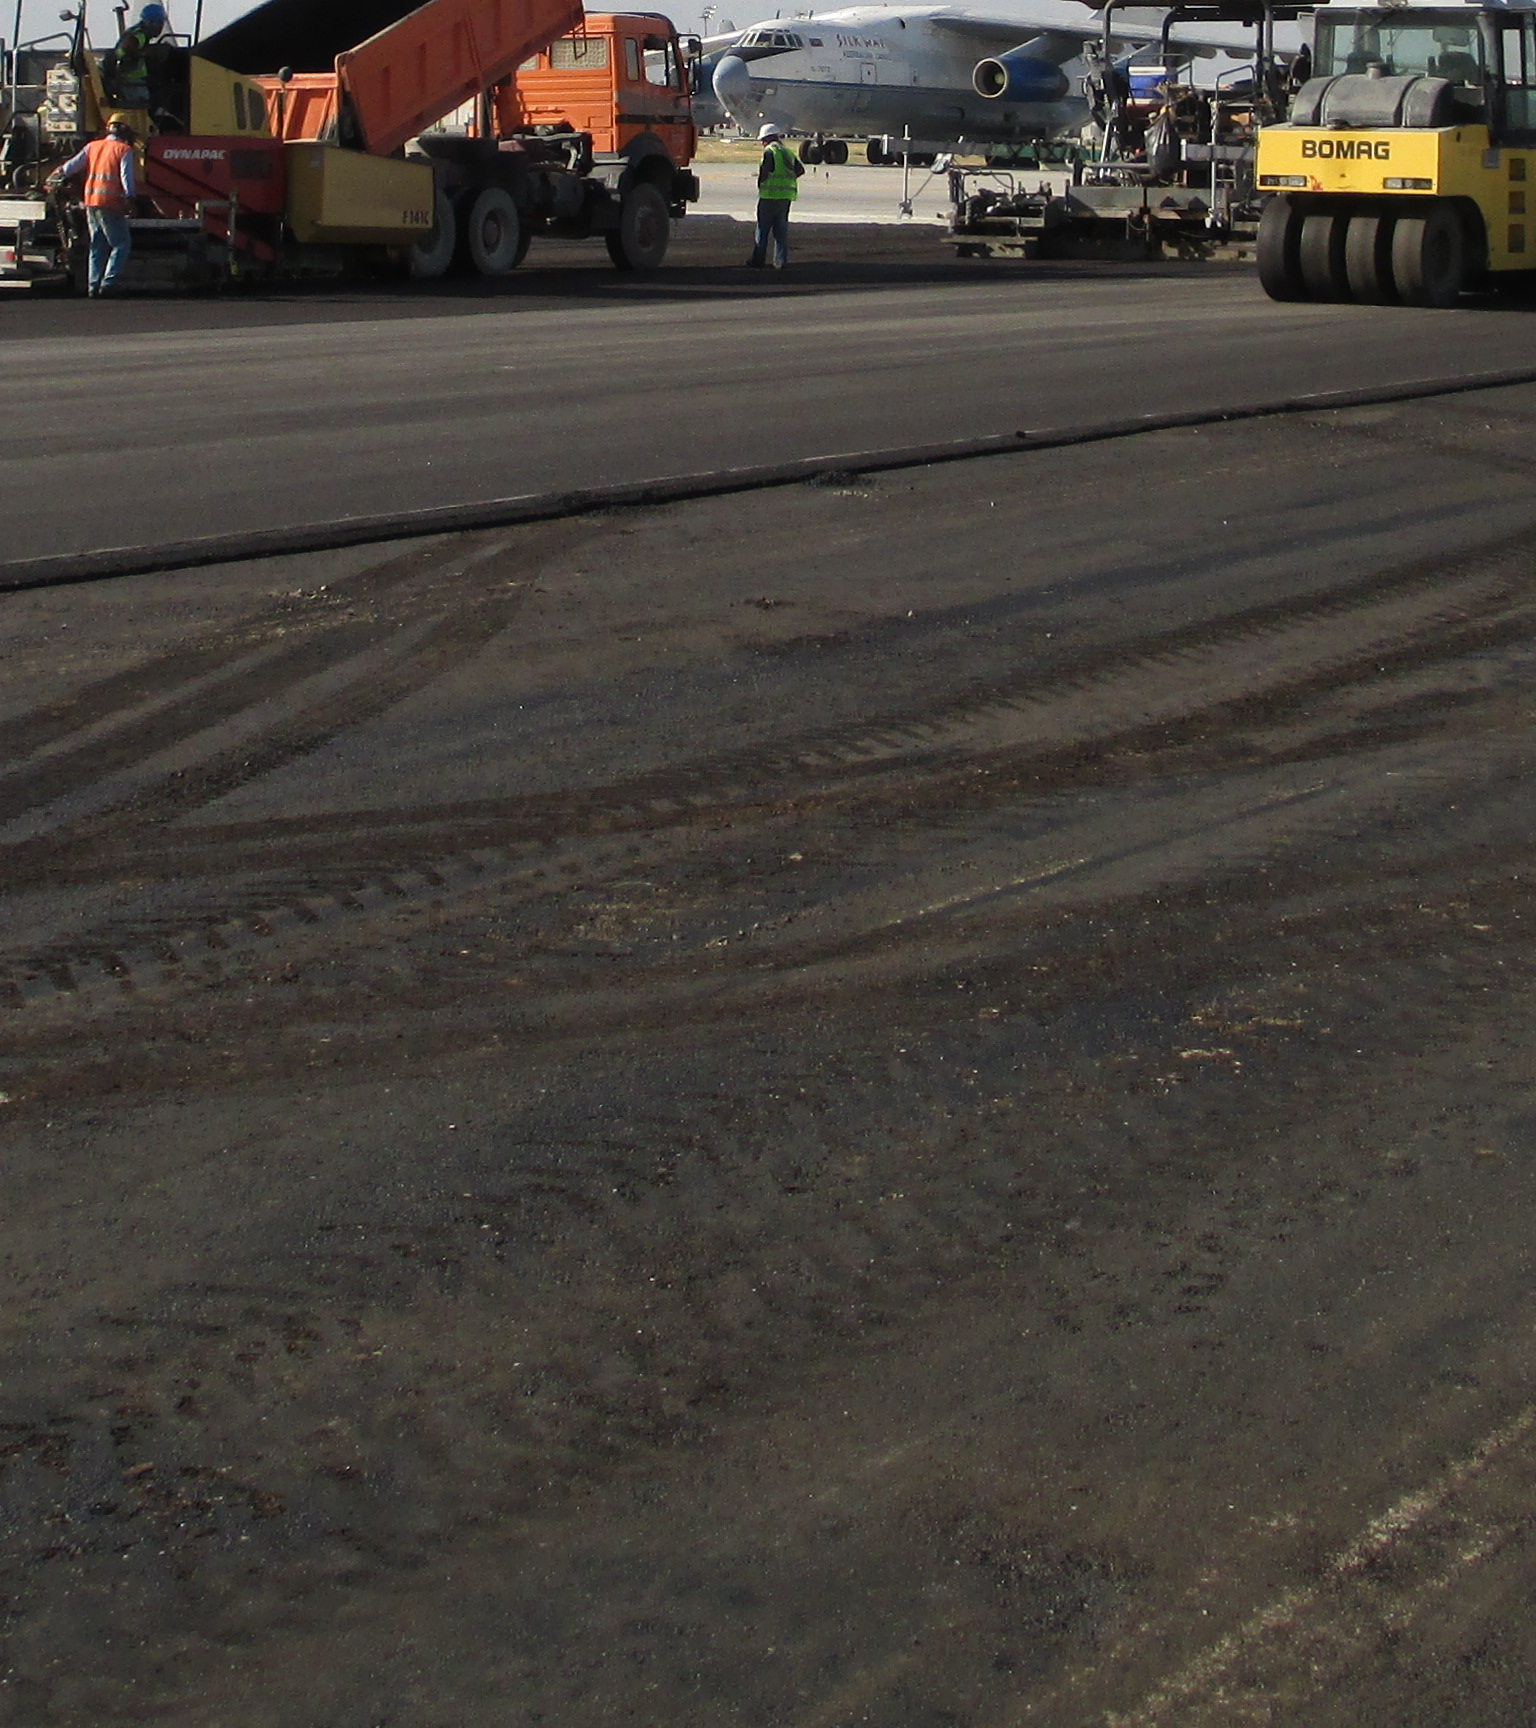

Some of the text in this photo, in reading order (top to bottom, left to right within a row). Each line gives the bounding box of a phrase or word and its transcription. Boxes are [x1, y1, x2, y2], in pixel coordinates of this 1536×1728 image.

[835, 34, 862, 47] SILK
[163, 149, 227, 160] DYNAPAC
[1302, 139, 1390, 160] BOMAG
